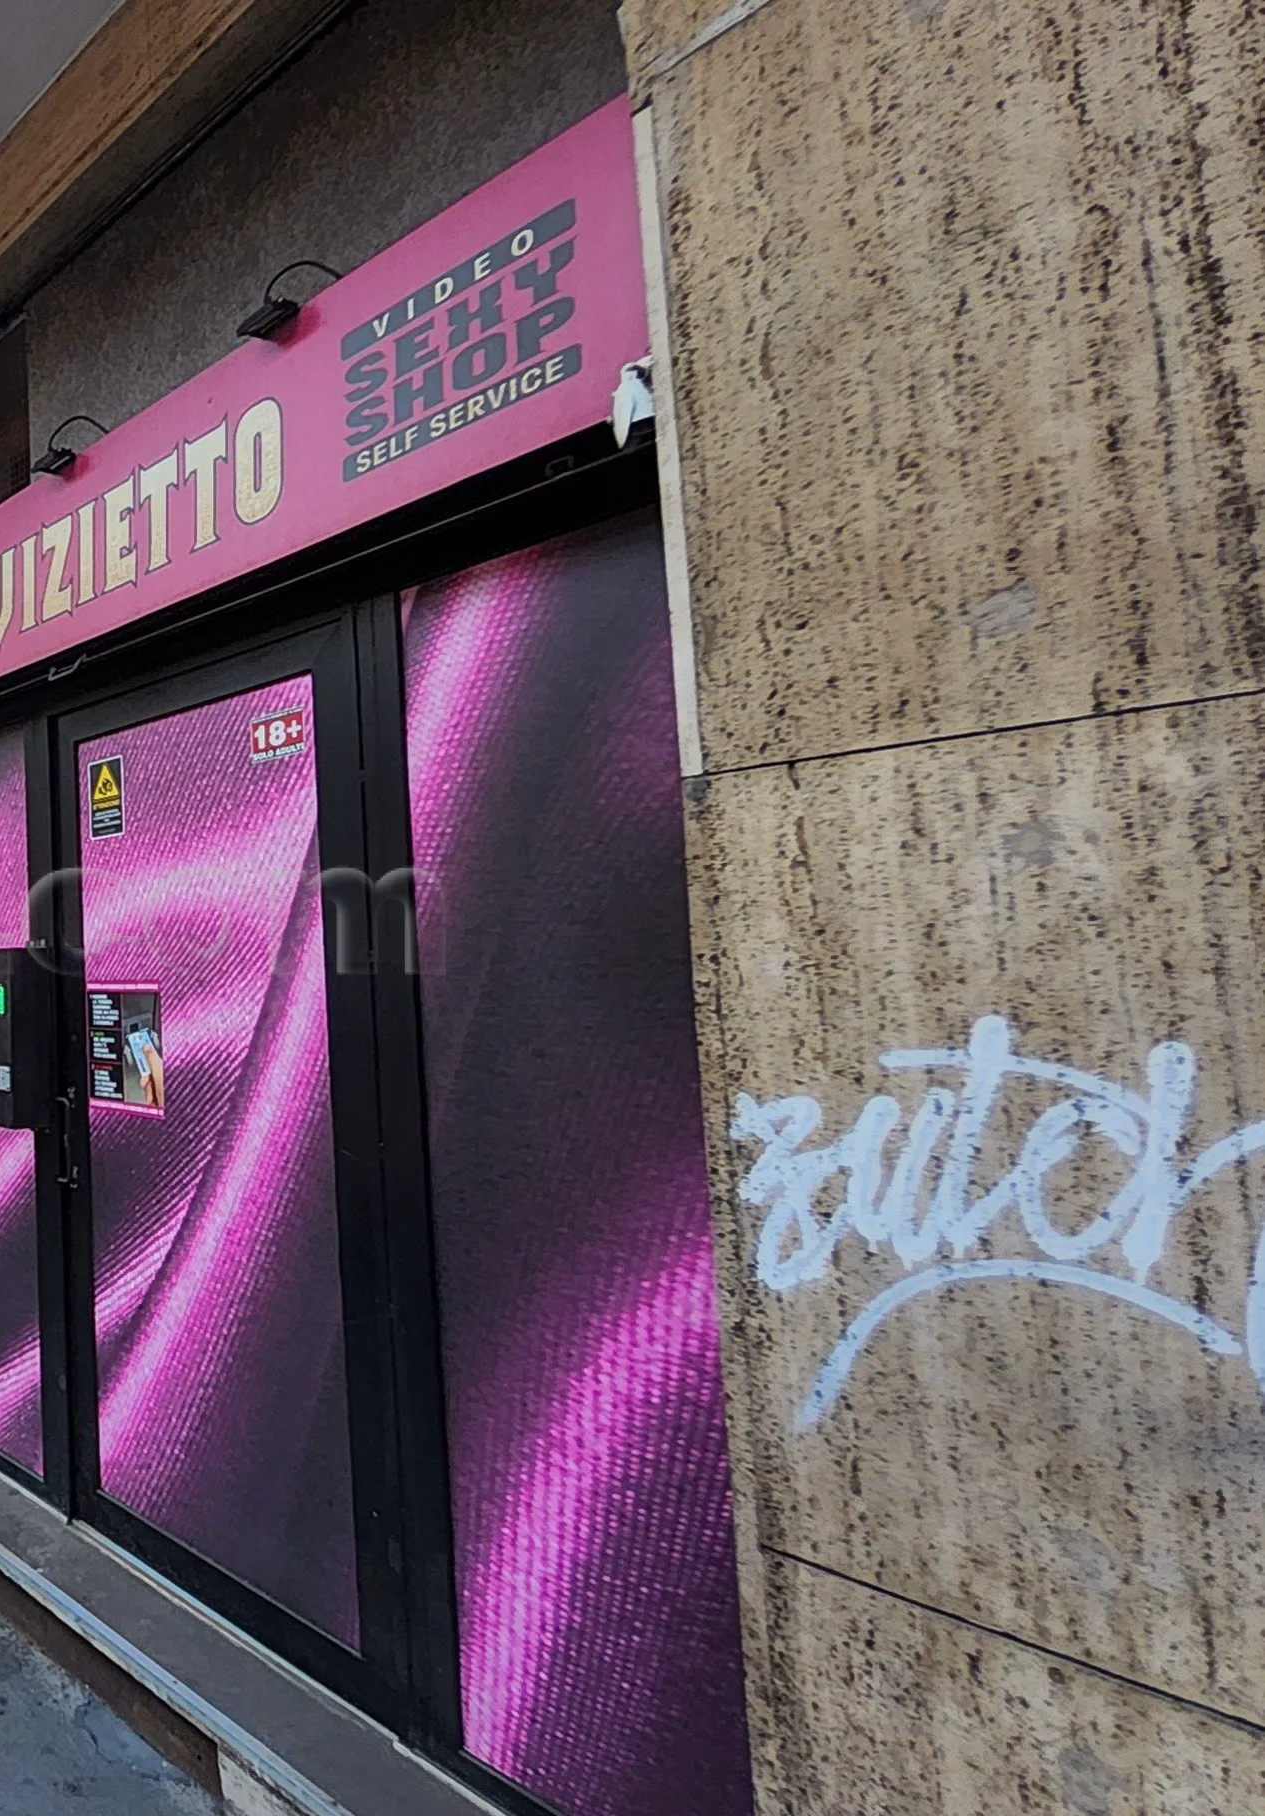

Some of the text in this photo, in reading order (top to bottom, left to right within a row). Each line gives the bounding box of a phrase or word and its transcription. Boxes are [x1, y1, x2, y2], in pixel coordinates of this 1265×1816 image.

[344, 235, 578, 403] SEXY
[372, 229, 534, 338] VIDEO
[345, 296, 576, 447] SHOP
[356, 355, 566, 473] SELF SERVICE
[254, 719, 302, 749] 18+
